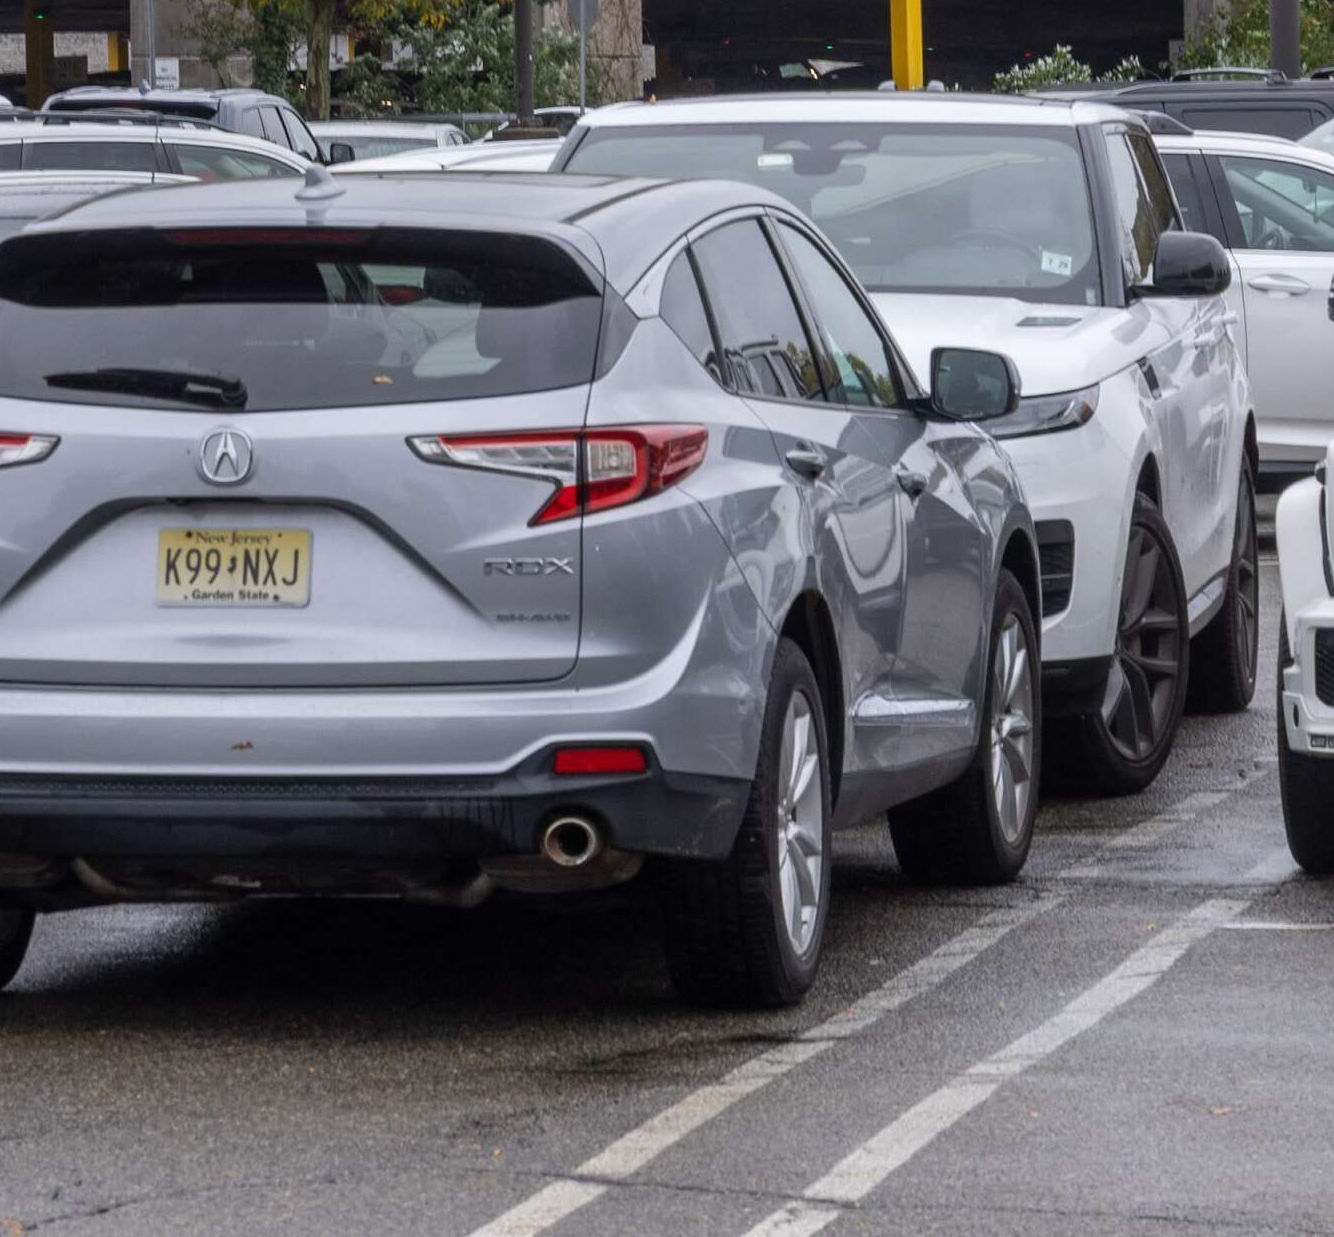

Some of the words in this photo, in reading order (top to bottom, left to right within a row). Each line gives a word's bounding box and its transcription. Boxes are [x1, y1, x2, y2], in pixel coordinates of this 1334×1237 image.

[195, 530, 225, 544] New
[228, 529, 274, 547] Jersey
[164, 547, 222, 586] K99
[242, 547, 300, 587] NXJ
[483, 556, 574, 576] RDX
[191, 588, 234, 601] Garden
[238, 589, 270, 602] State
